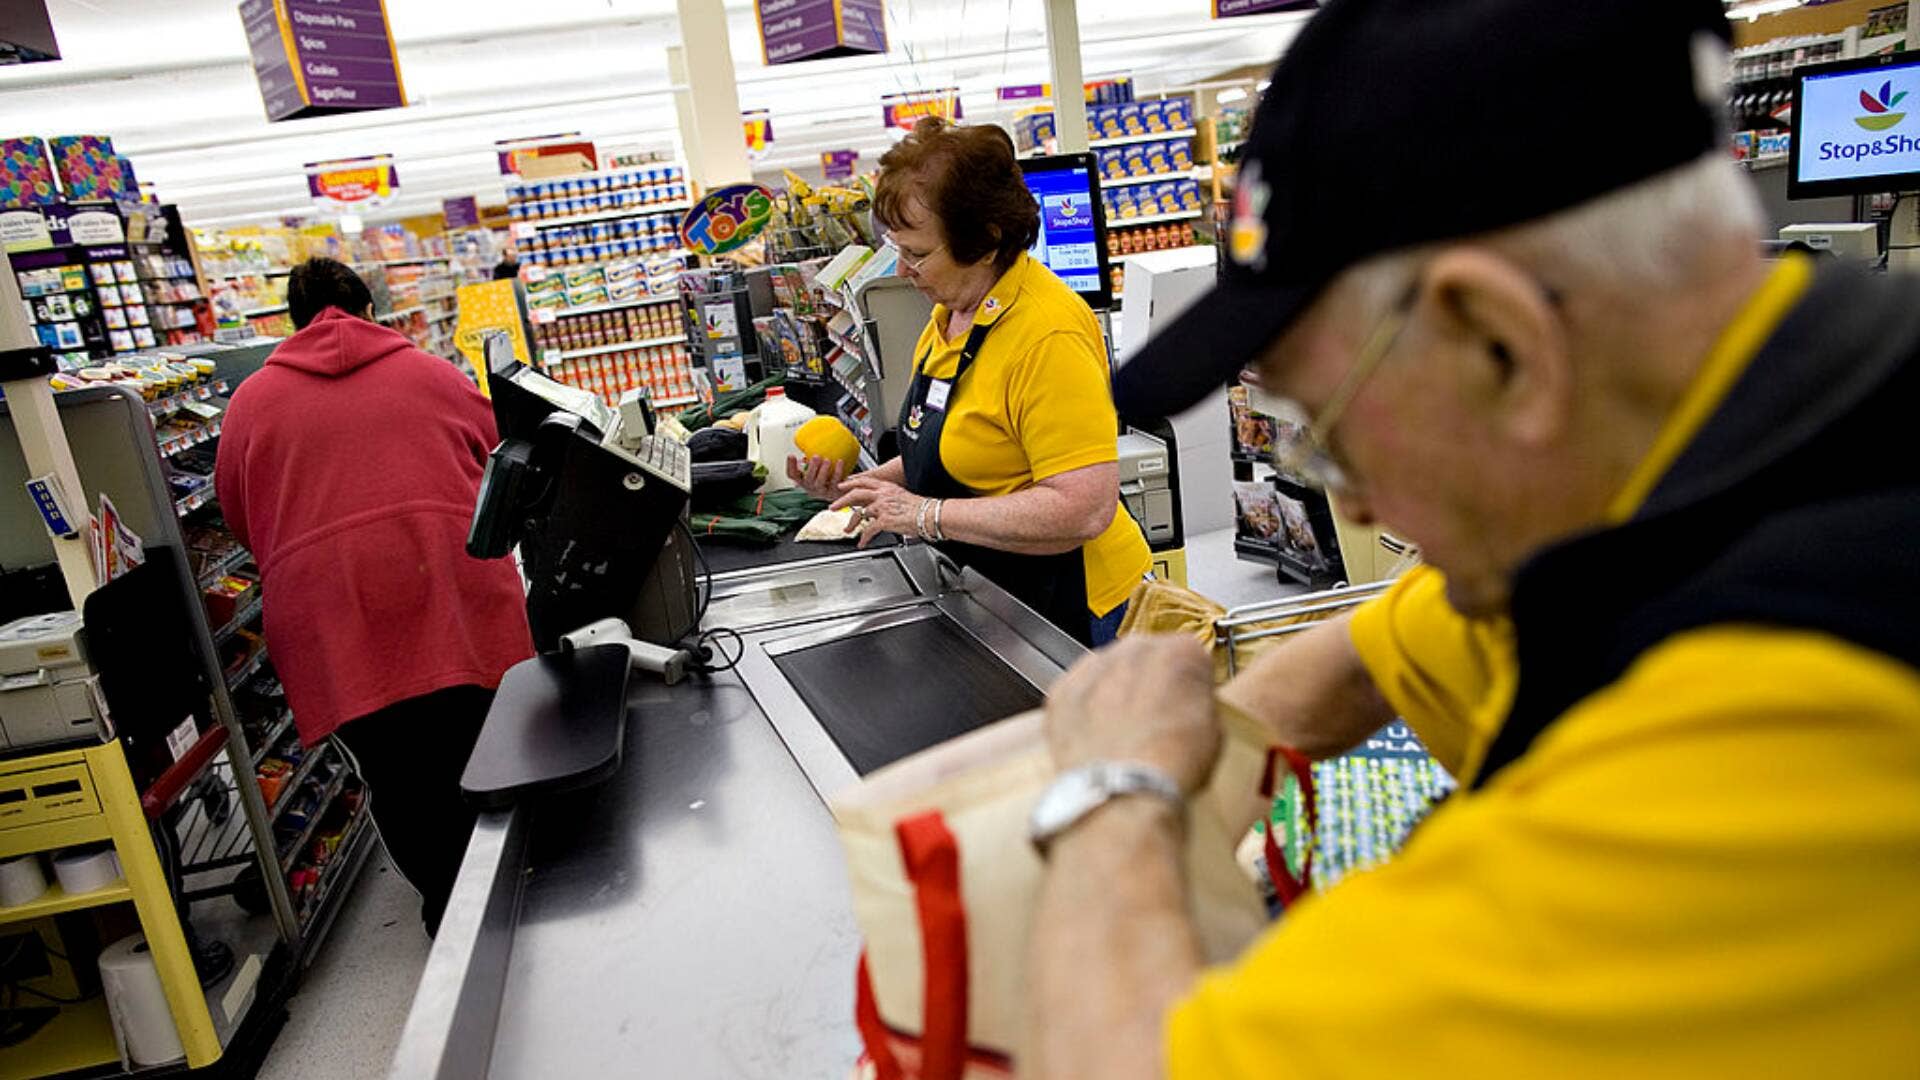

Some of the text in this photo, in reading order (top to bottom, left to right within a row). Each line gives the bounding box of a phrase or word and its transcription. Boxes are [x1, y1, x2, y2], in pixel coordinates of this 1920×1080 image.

[306, 63, 340, 76] Cookies
[687, 189, 771, 253] TOYS
[1367, 740, 1424, 752] PLA
